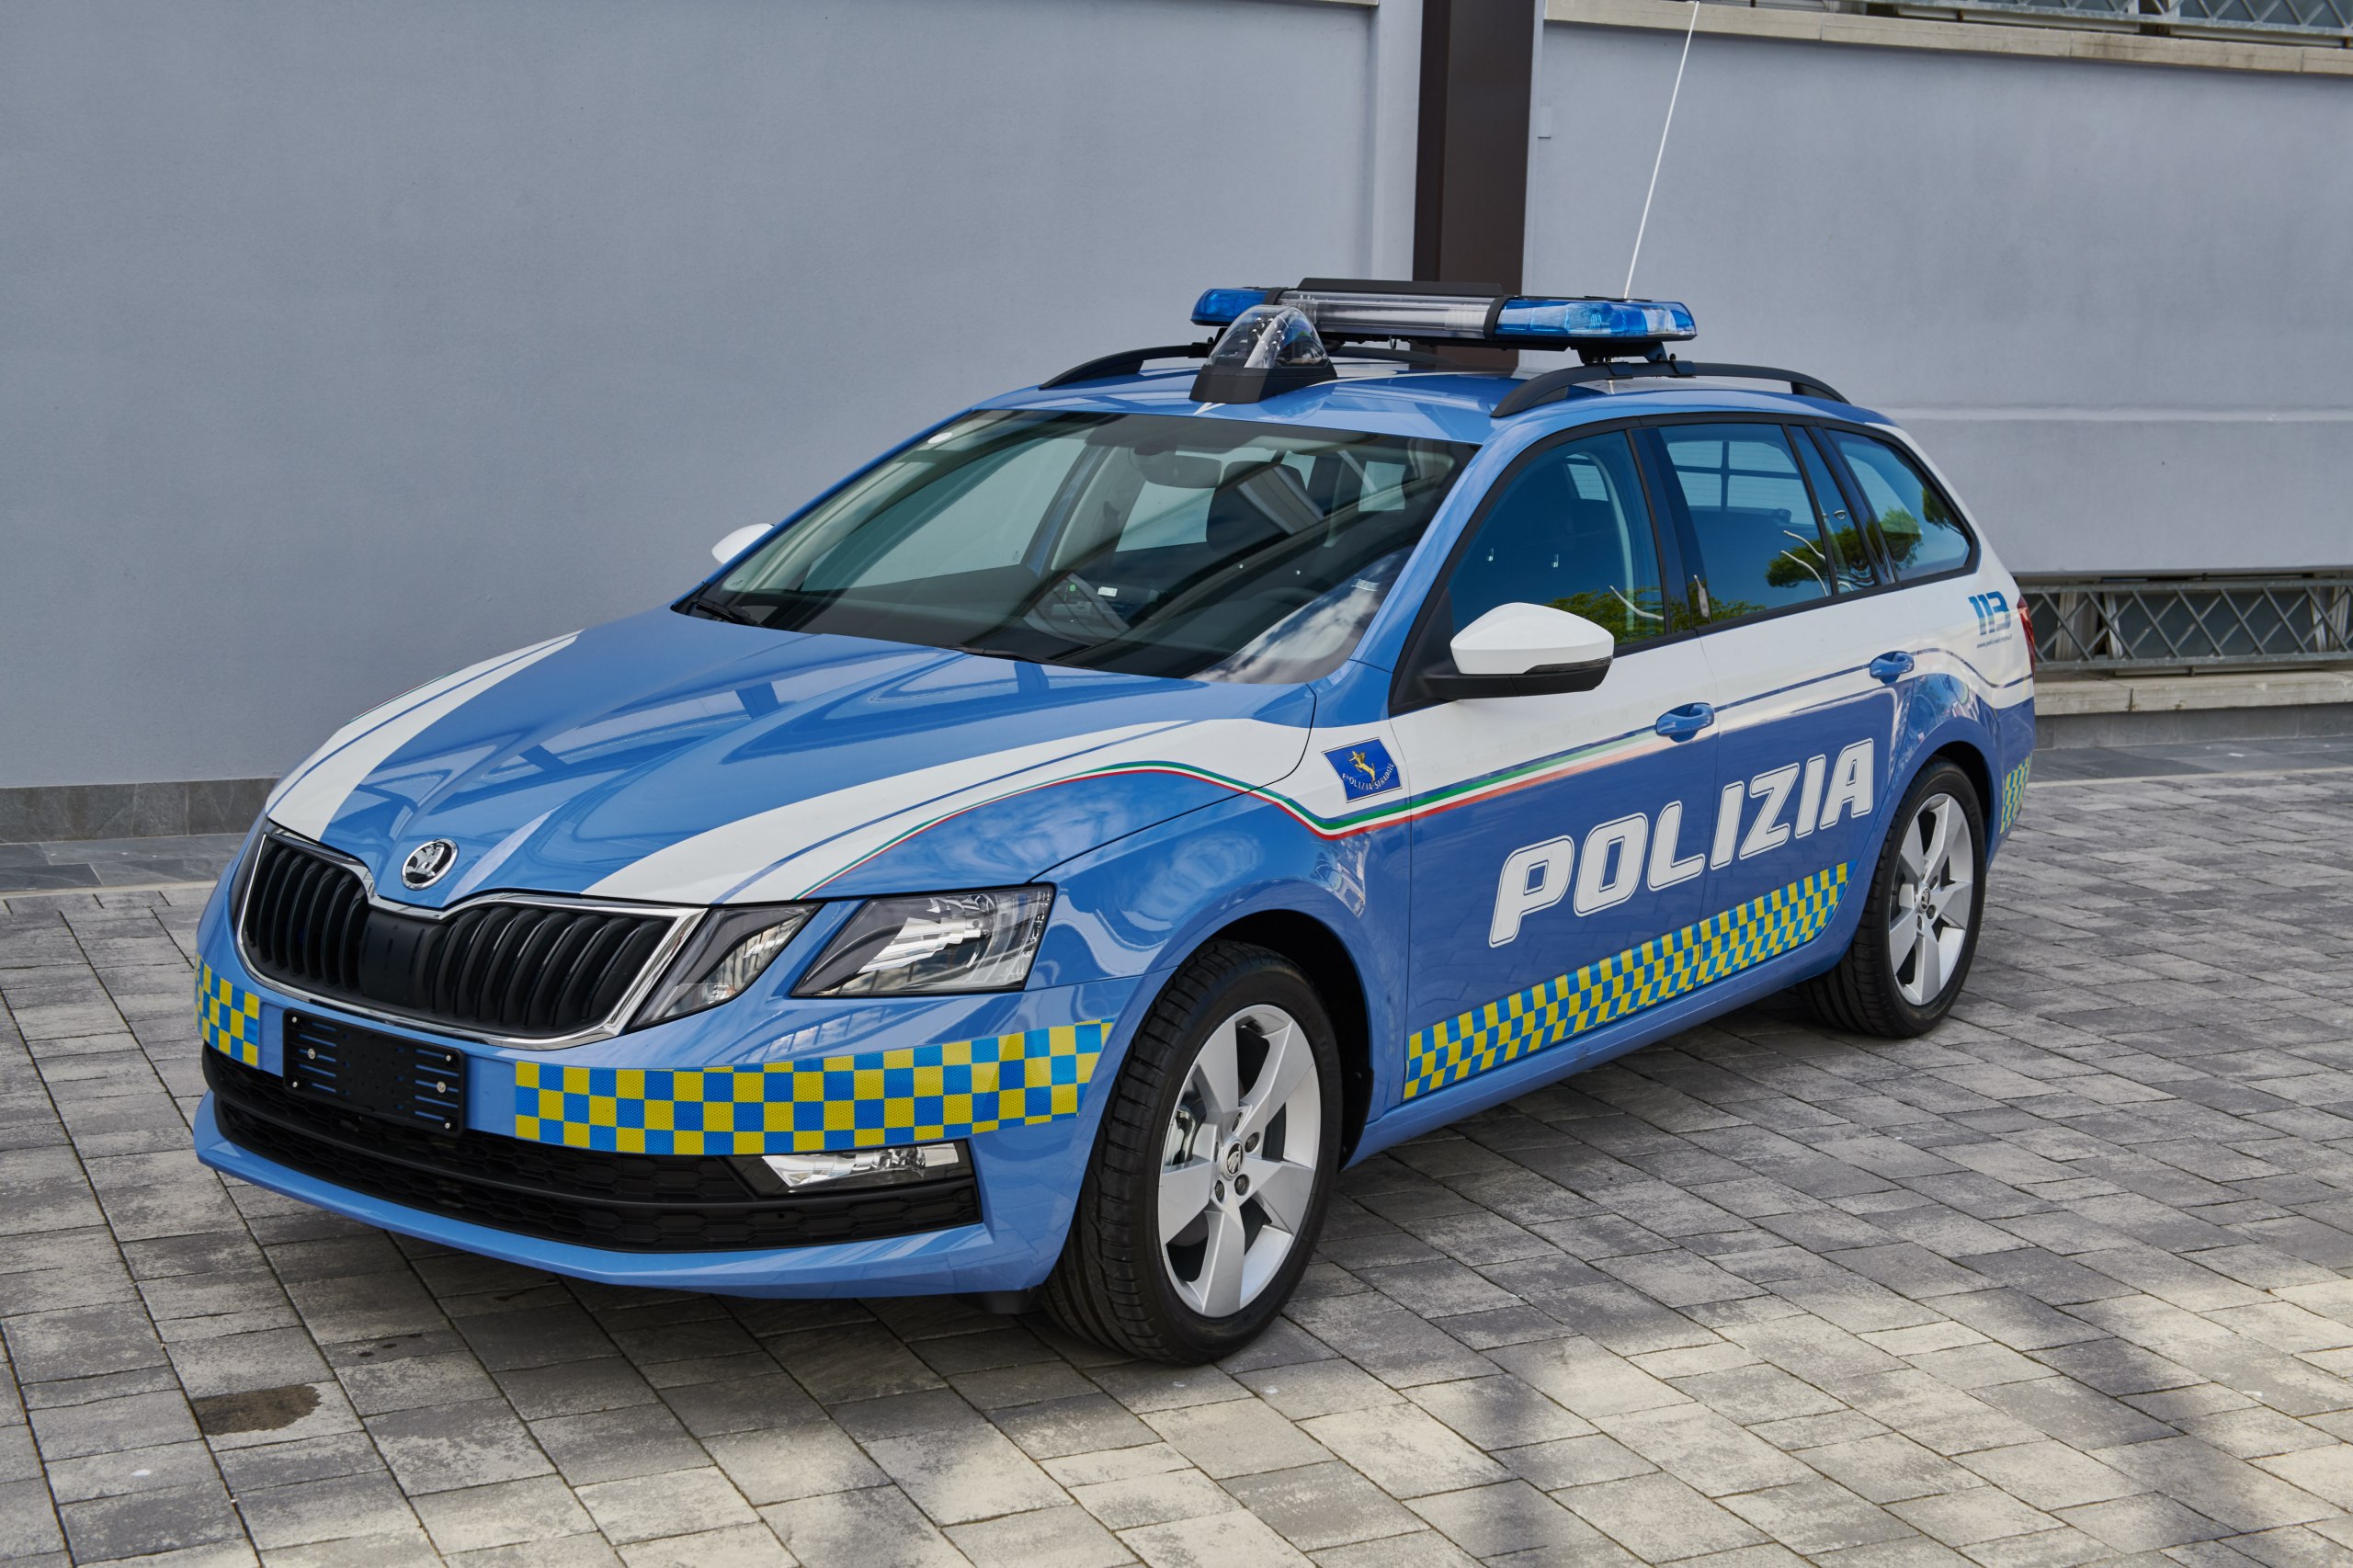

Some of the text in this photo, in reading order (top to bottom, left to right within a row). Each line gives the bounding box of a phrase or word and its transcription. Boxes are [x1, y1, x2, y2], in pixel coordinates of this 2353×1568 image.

[1968, 591, 2011, 635] 113
[1342, 773, 1373, 790] POLIZIA
[1488, 738, 1874, 949] POLIZIA
